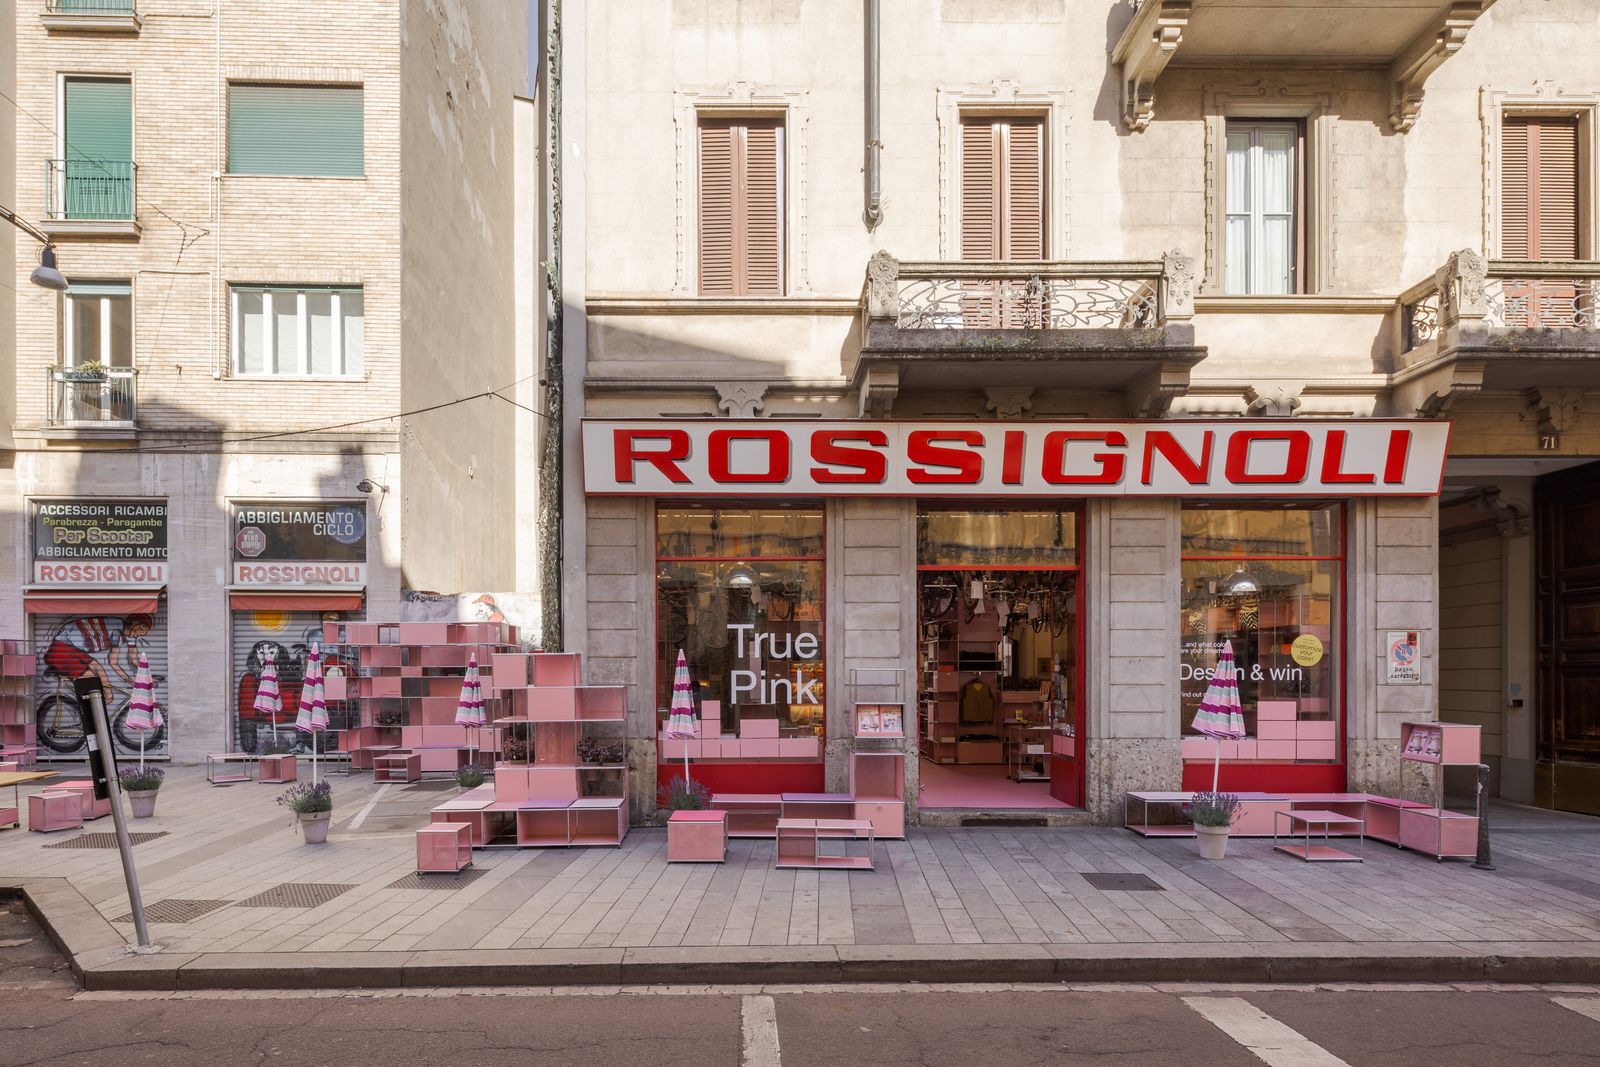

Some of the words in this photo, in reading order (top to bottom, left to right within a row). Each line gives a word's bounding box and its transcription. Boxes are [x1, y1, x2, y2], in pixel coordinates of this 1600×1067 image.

[1541, 436, 1555, 449] 71
[613, 429, 1412, 484] ROSSIGNOLI
[40, 505, 110, 516] ACCESSORI
[114, 506, 167, 516] RICAMBI
[43, 517, 98, 526] Parabrezza
[107, 517, 163, 529] Paragambe
[237, 511, 354, 524] ABBIGLIAMENTO
[53, 526, 86, 544] Per
[87, 526, 154, 545] Scooter
[313, 524, 354, 536] CICLO
[38, 546, 133, 557] ABBIGLIAMENTO
[40, 565, 162, 582] ROSSIGNOLI
[239, 565, 360, 582] ROSSIGNOLI
[727, 624, 818, 659] True
[1292, 643, 1322, 653] customize
[1190, 648, 1203, 656] your
[1180, 663, 1245, 680] Desn
[1250, 664, 1265, 680] &
[1270, 664, 1303, 680] win
[731, 668, 819, 705] Pink
